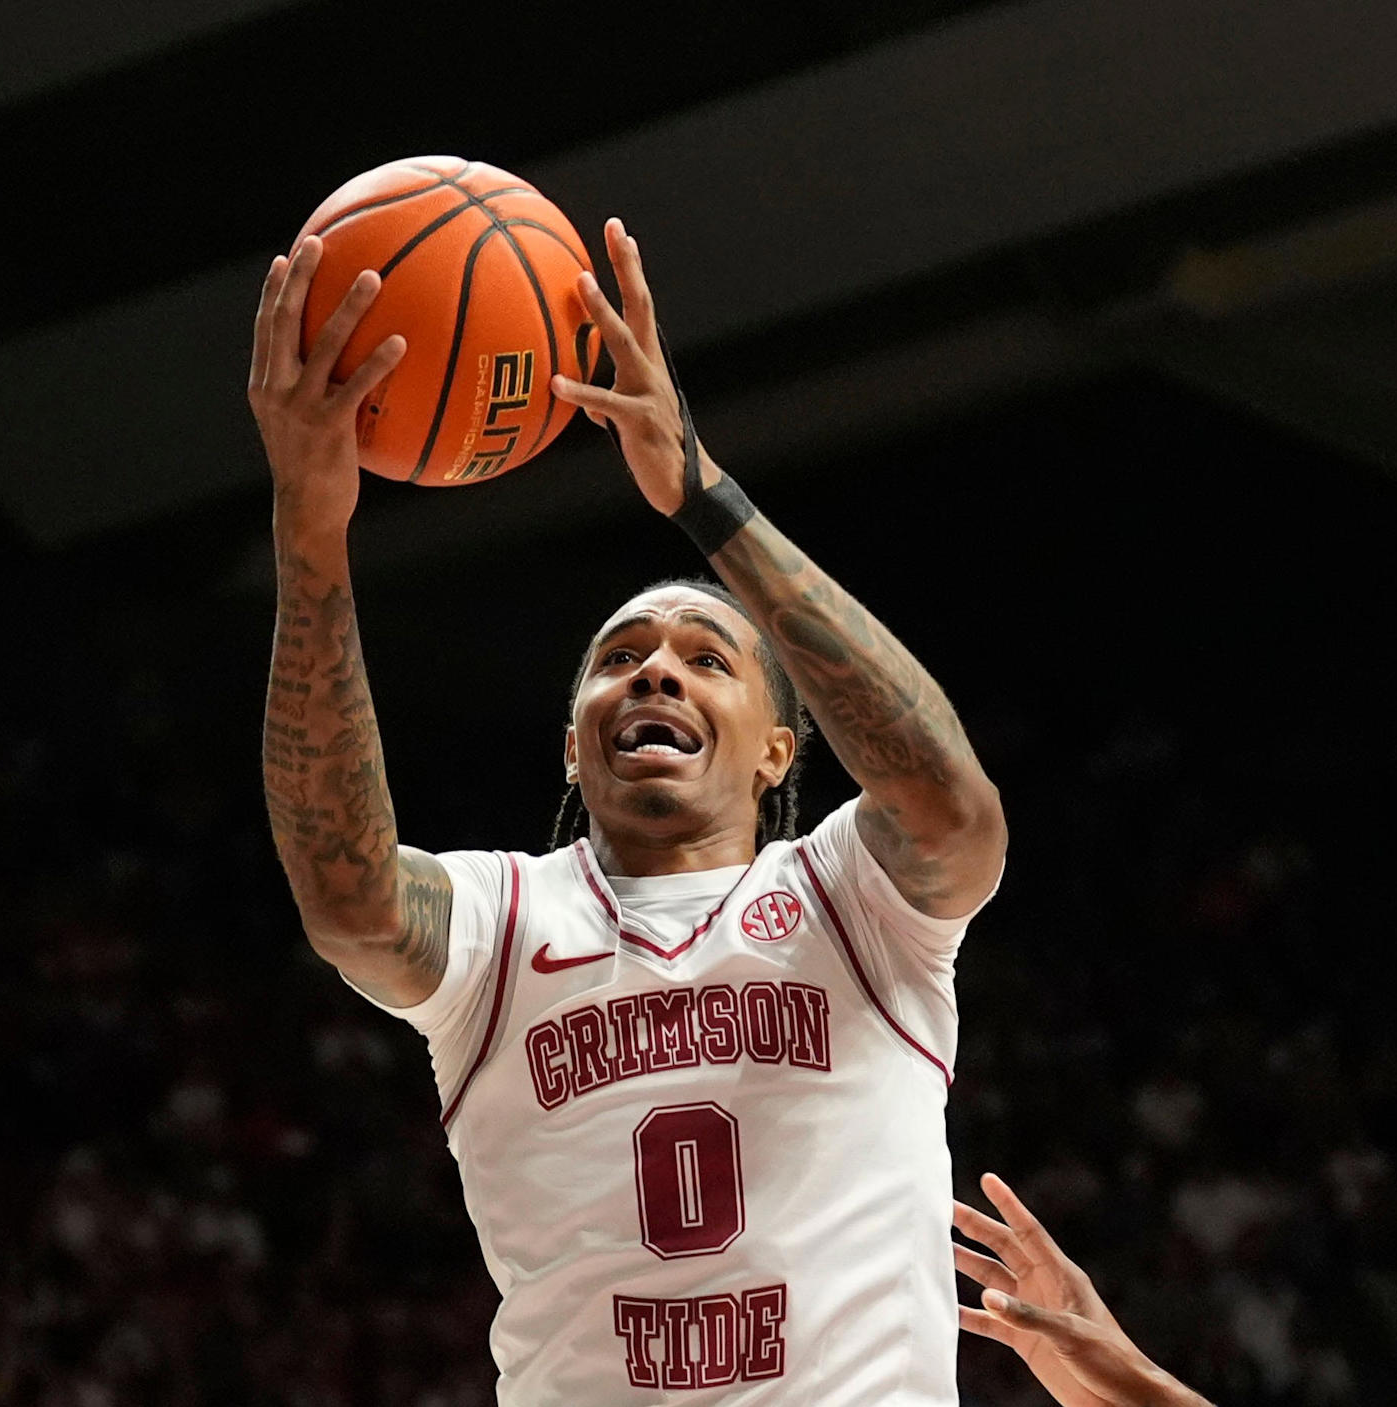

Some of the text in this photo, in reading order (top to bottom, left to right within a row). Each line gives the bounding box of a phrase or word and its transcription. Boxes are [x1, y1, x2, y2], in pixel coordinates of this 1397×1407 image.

[455, 349, 535, 480] ELITE
[743, 892, 799, 940] SEC
[525, 981, 832, 1112] CRIMSON
[633, 1101, 746, 1261] 0
[614, 1283, 788, 1390] TIDE
